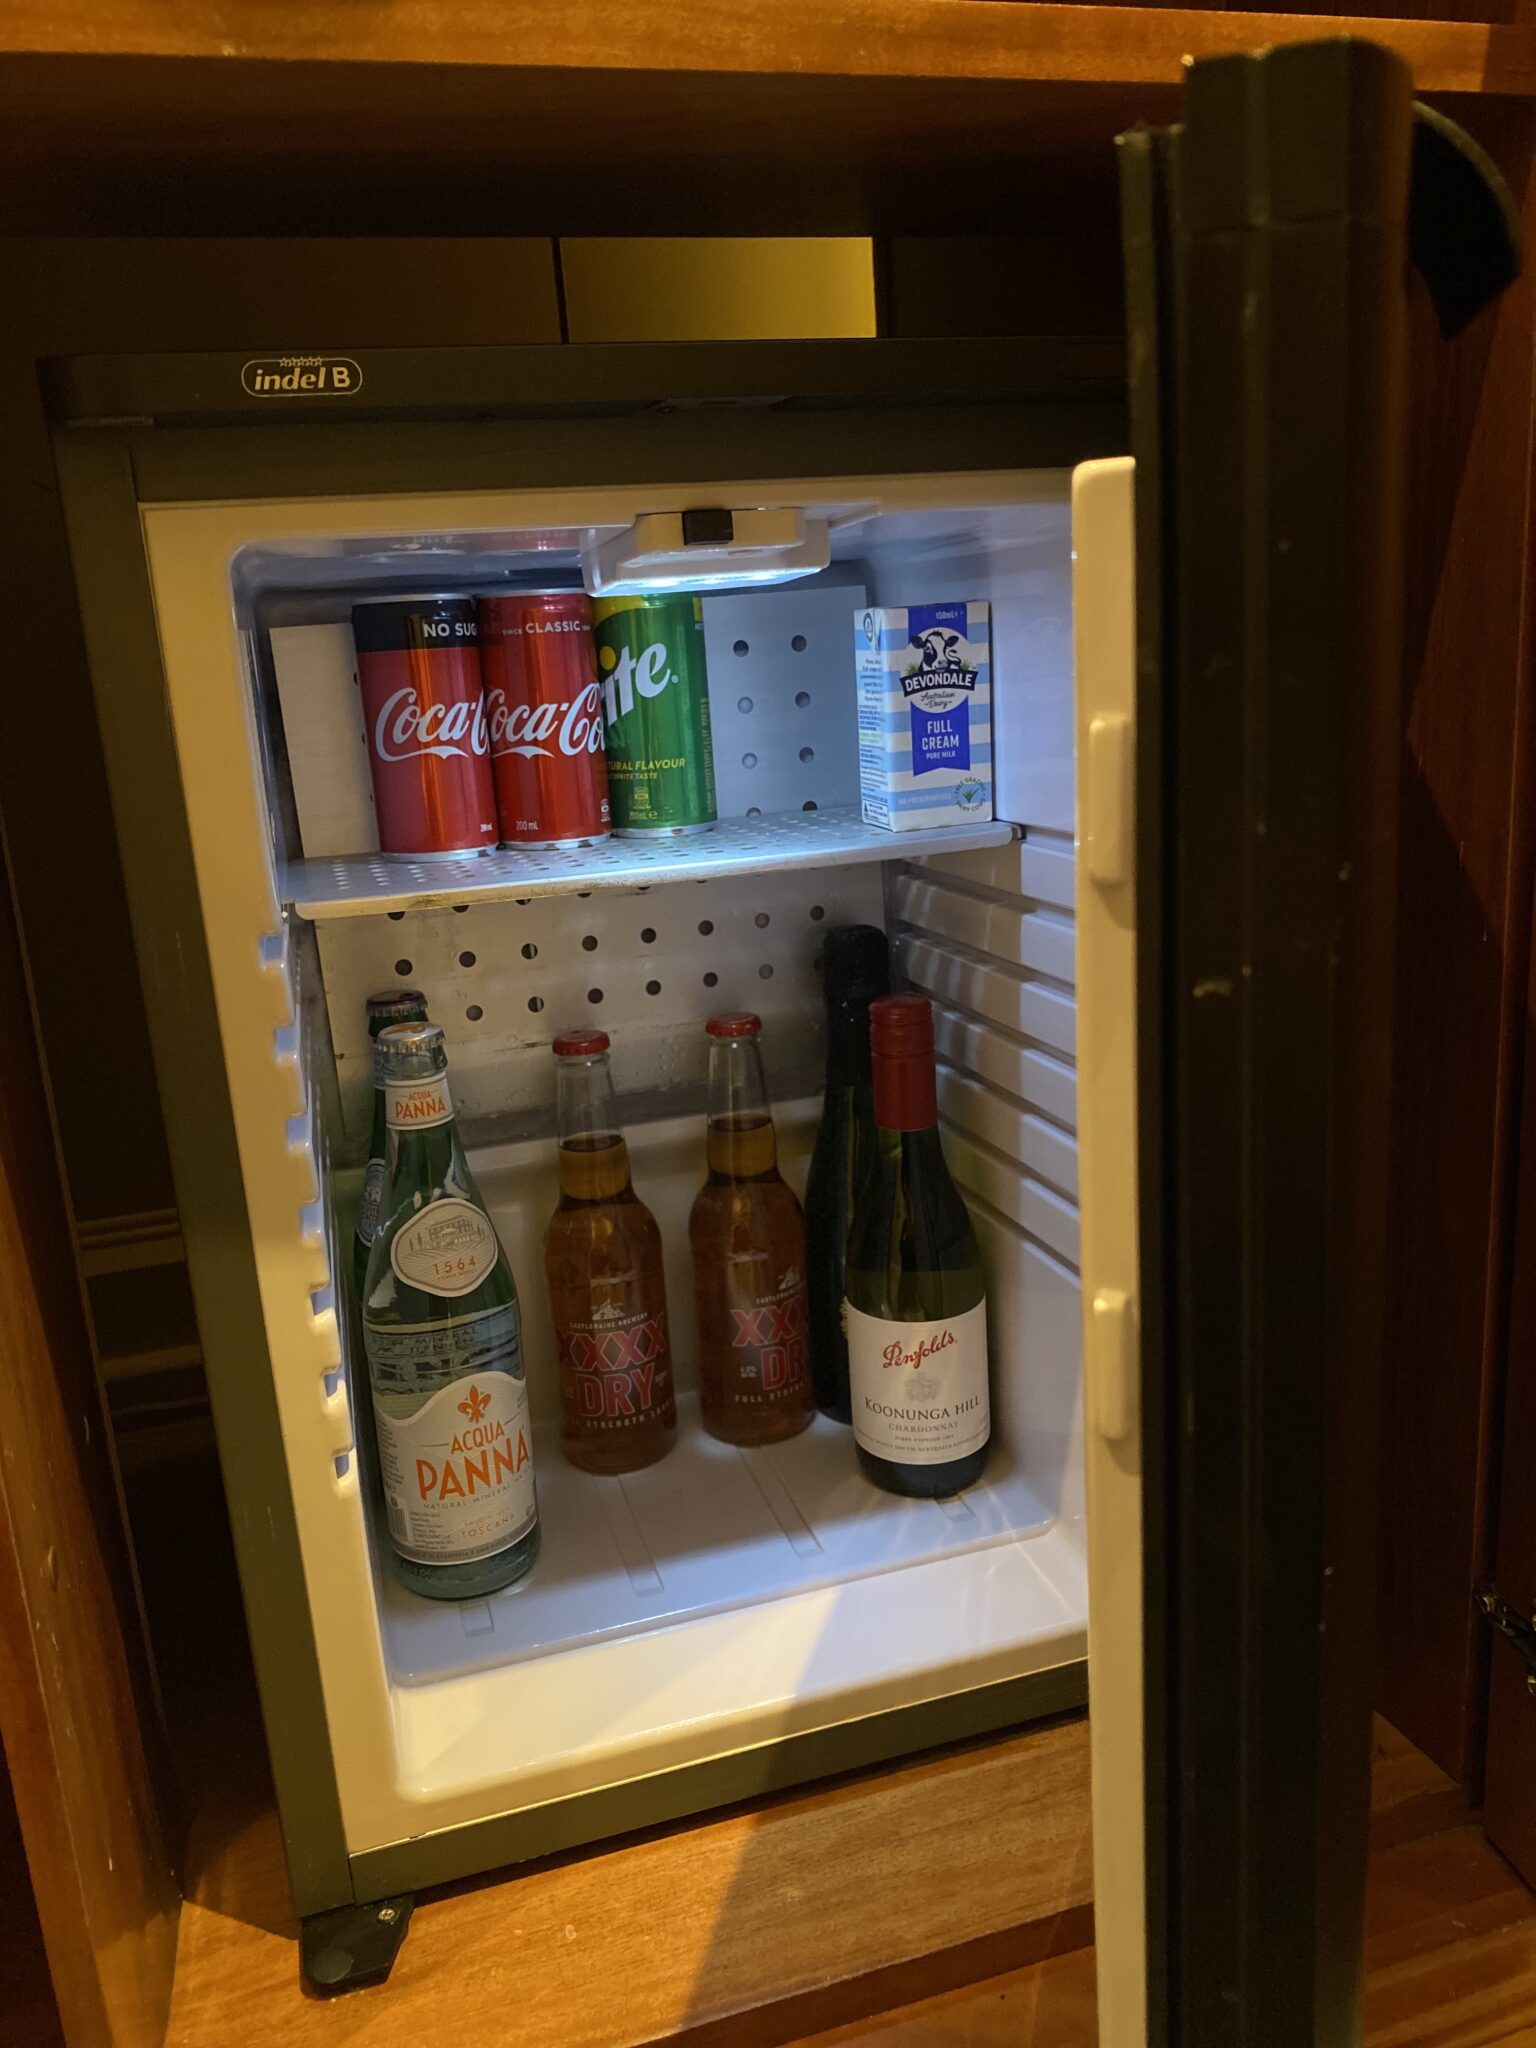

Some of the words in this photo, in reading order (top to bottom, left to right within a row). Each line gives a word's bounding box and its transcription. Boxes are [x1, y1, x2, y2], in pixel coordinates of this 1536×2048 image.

[254, 366, 327, 391] indel
[332, 366, 351, 388] B
[422, 623, 450, 638] NO
[455, 622, 478, 637] SUG
[525, 621, 581, 634] CLASSIC
[601, 642, 671, 727] ite
[904, 672, 974, 692] DEVONDALE
[375, 687, 489, 762] Coca-C
[485, 682, 606, 758] Coca-Co
[926, 719, 953, 734] FULL
[921, 734, 960, 751] CREAM
[926, 751, 942, 760] PURE
[941, 749, 956, 759] MILK
[607, 761, 634, 771] TURAL
[635, 758, 686, 771] FLAVOUR
[394, 1095, 447, 1120] PANNA
[408, 1089, 432, 1101] ACQUA
[432, 1254, 477, 1277] 1564
[882, 1329, 956, 1370] Penfolds
[759, 1338, 807, 1391] DR
[575, 1361, 656, 1418] DRY
[864, 1396, 951, 1421] KOONUNGA
[955, 1395, 981, 1416] HILL
[450, 1420, 506, 1455] ACQUA
[888, 1421, 959, 1433] CHARDONNAY
[415, 1427, 530, 1501] PANNA
[423, 1500, 467, 1510] NATURAL
[472, 1484, 511, 1504] MINERAL
[461, 1513, 516, 1538] TOSCANA
